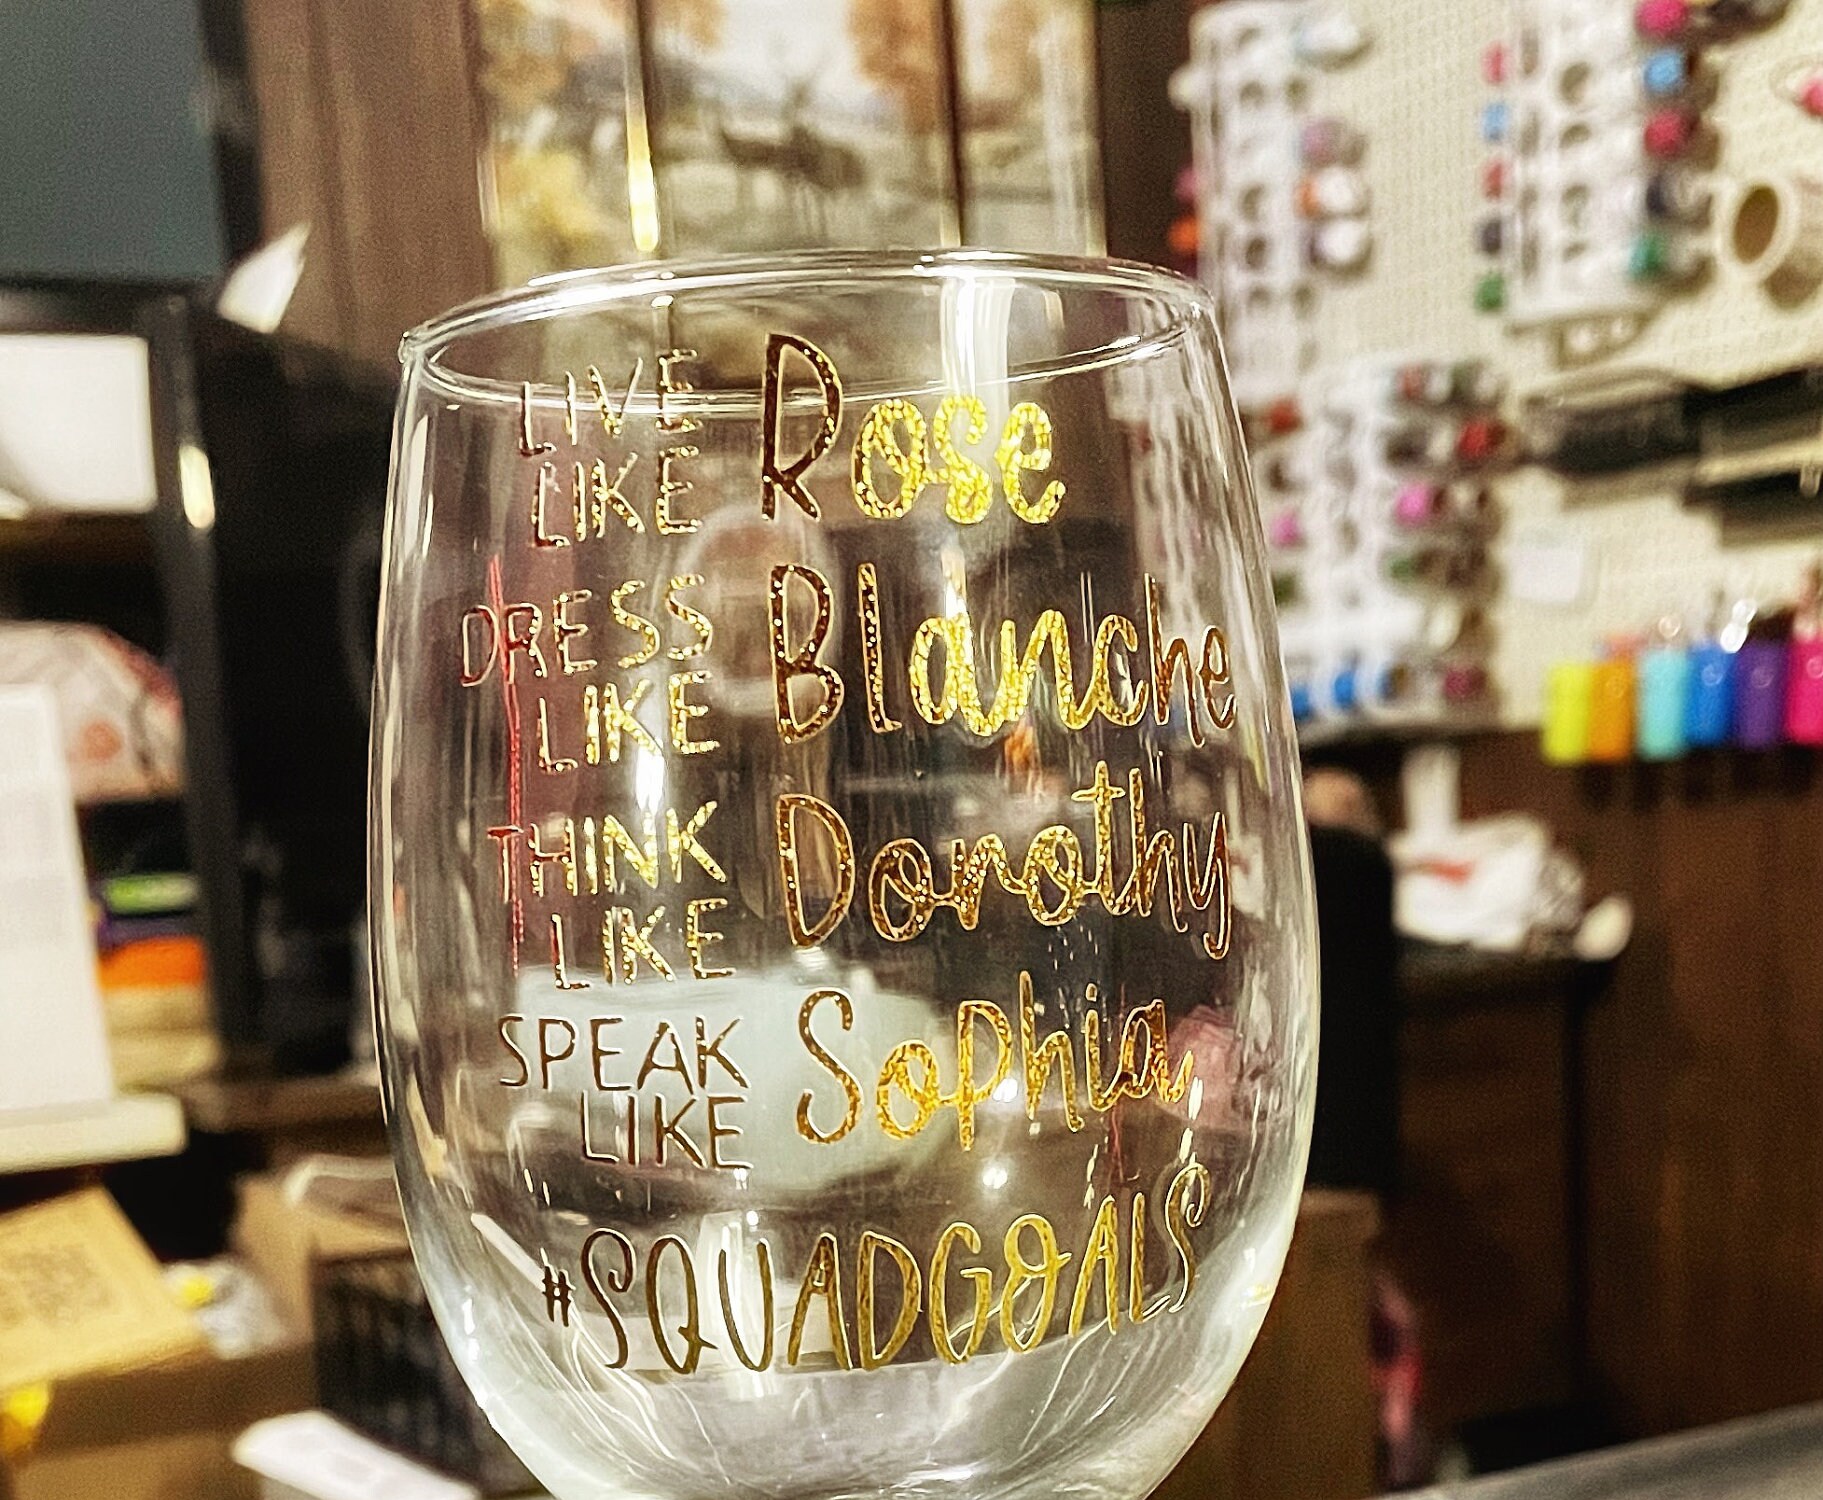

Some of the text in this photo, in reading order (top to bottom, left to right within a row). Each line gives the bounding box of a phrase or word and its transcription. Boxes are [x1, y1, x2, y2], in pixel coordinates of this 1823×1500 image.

[519, 348, 702, 455] LIVE
[760, 332, 1066, 525] Rose
[531, 446, 703, 548] LIKE
[460, 573, 714, 687] DRESS
[768, 562, 1237, 747] Blanche
[537, 670, 720, 776] LIKE
[487, 800, 729, 903] THINK
[776, 760, 1232, 960] Dorothy
[551, 897, 734, 991] LIKE
[497, 1013, 750, 1093] SPEAK
[795, 970, 1194, 1151] Sophia
[580, 1094, 753, 1170] LIKE
[541, 1162, 1212, 1375] #SQUADGOALS
